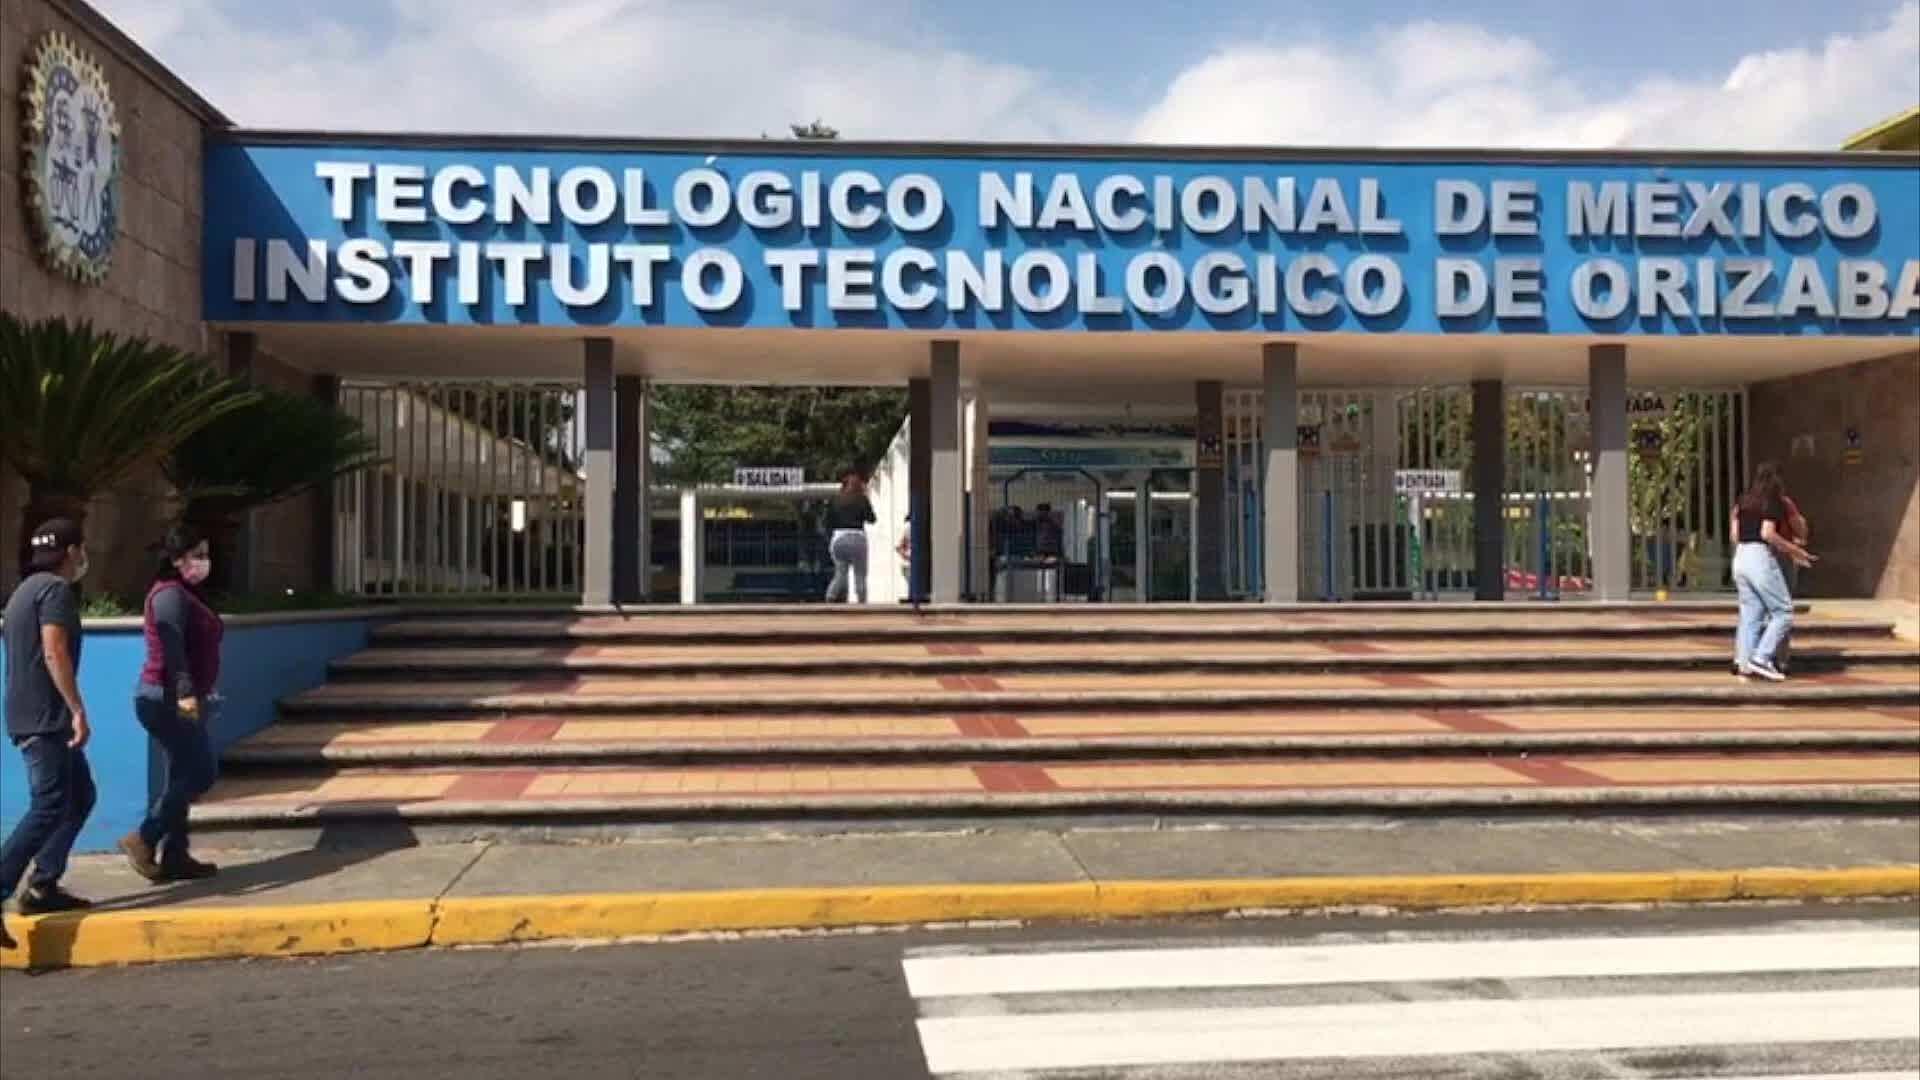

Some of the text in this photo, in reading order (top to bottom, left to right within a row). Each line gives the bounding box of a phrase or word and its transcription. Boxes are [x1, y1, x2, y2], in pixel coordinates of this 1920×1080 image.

[315, 155, 1877, 238] TECNOLÓGICO NACIONAL DE MÉXICO
[233, 238, 743, 311] INSTITUTO
[1434, 257, 1543, 318] DE
